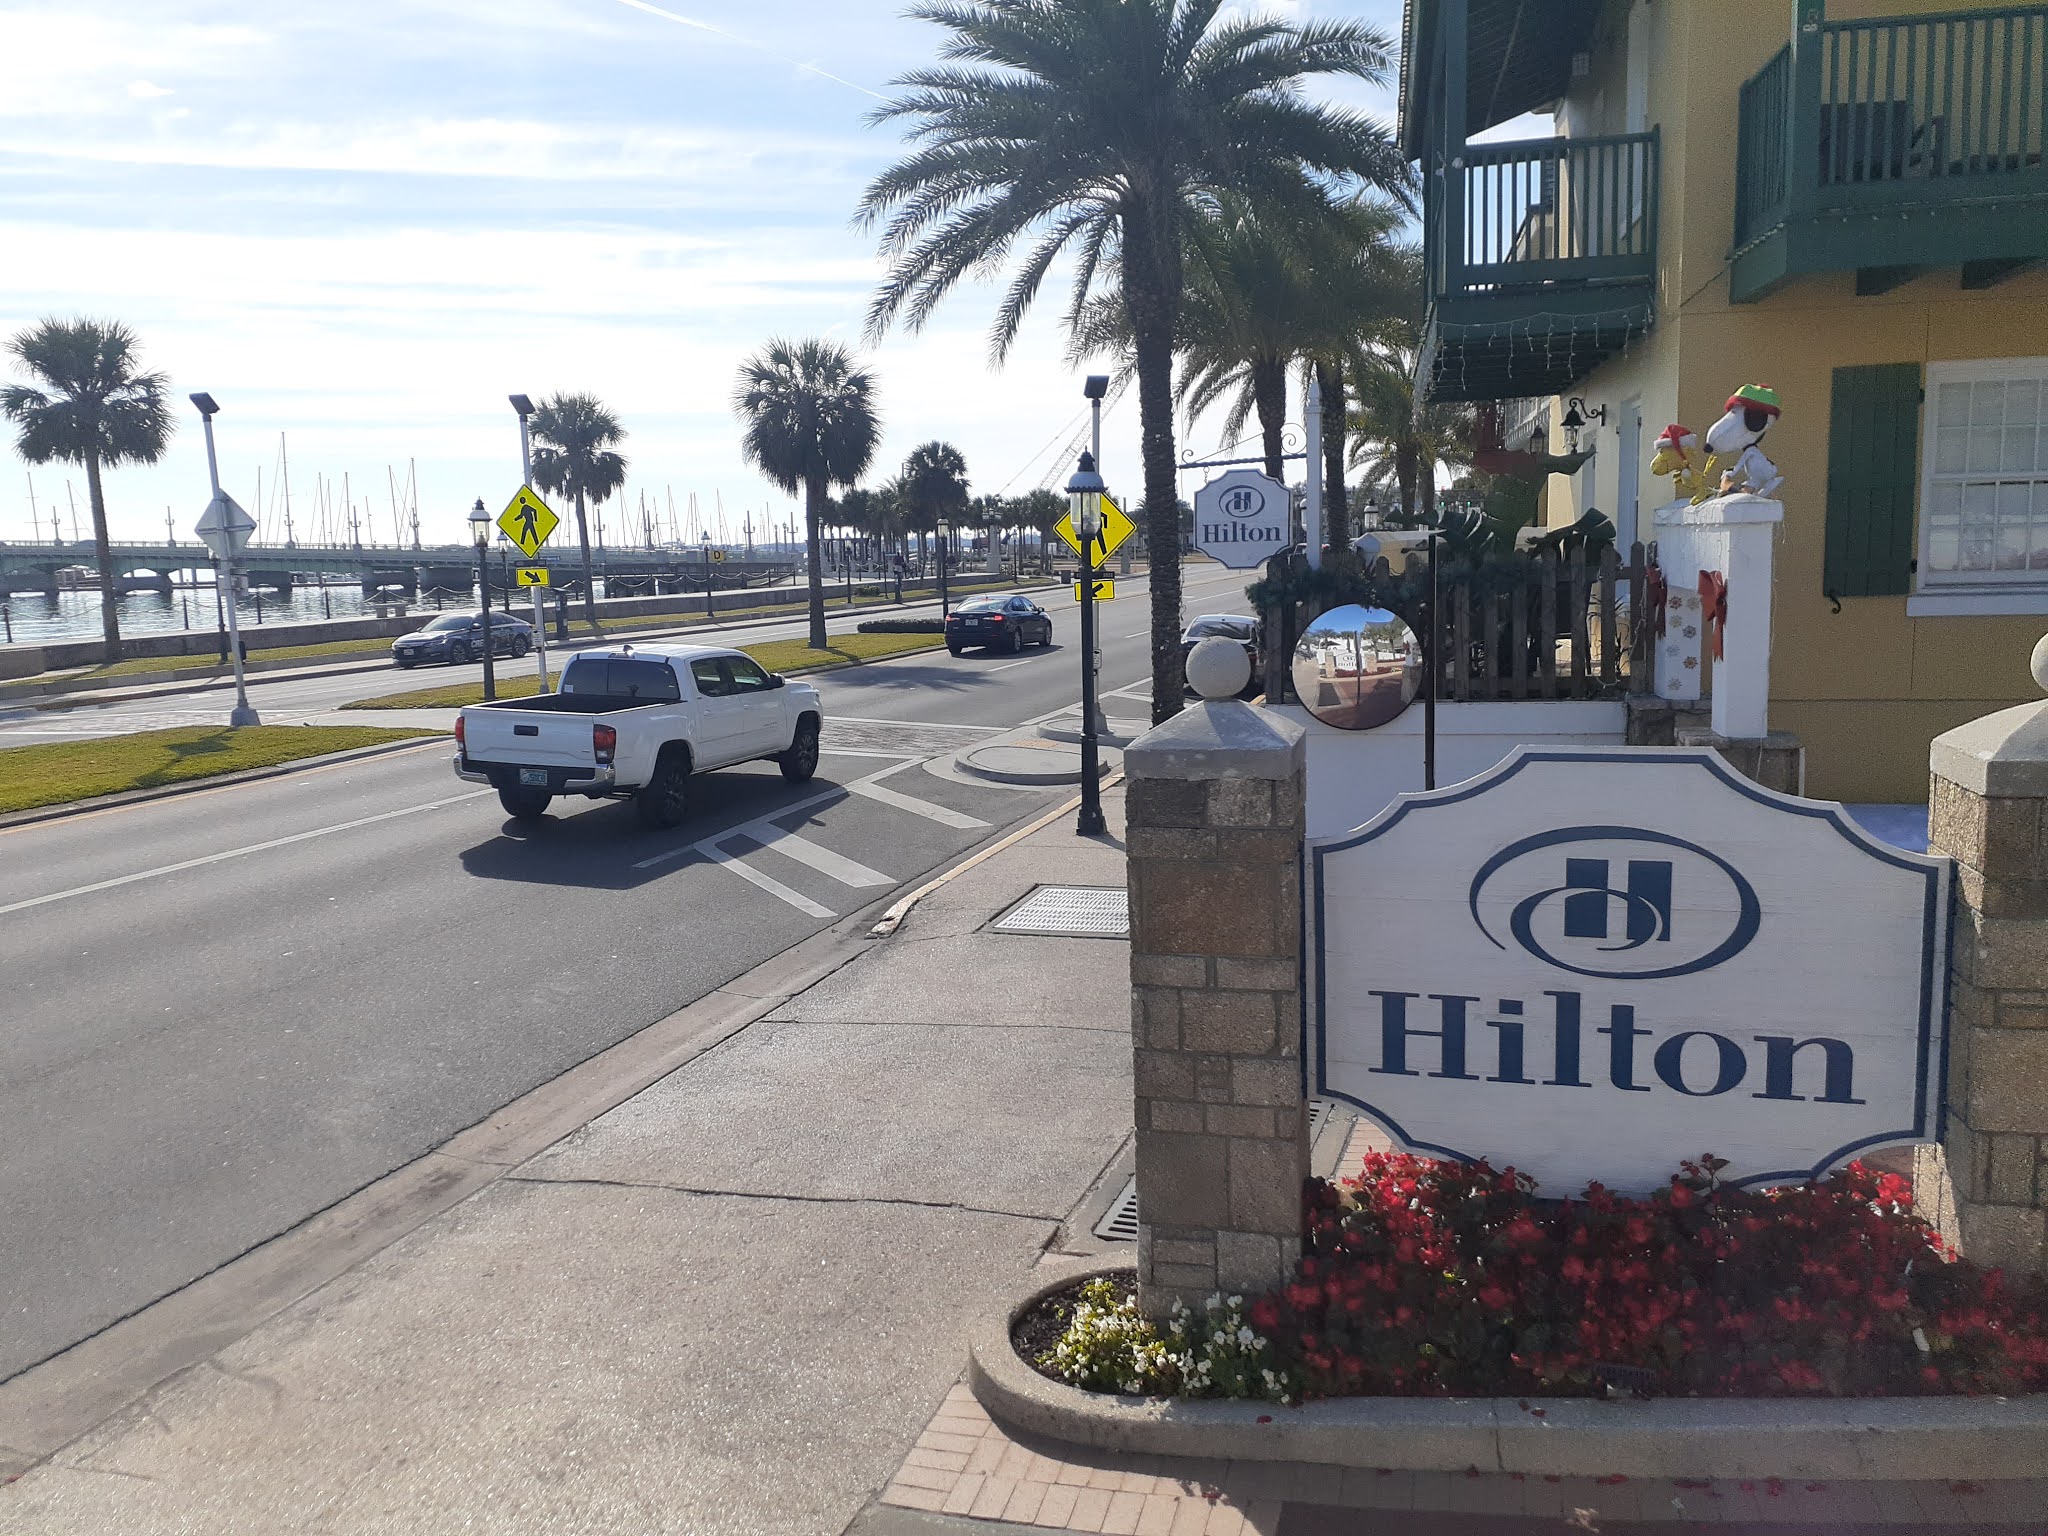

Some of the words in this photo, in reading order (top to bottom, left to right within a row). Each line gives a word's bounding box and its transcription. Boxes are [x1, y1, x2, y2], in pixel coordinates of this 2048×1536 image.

[1202, 521, 1282, 544] Hilton
[713, 550, 721, 560] D
[1367, 990, 1866, 1105] Hilton
